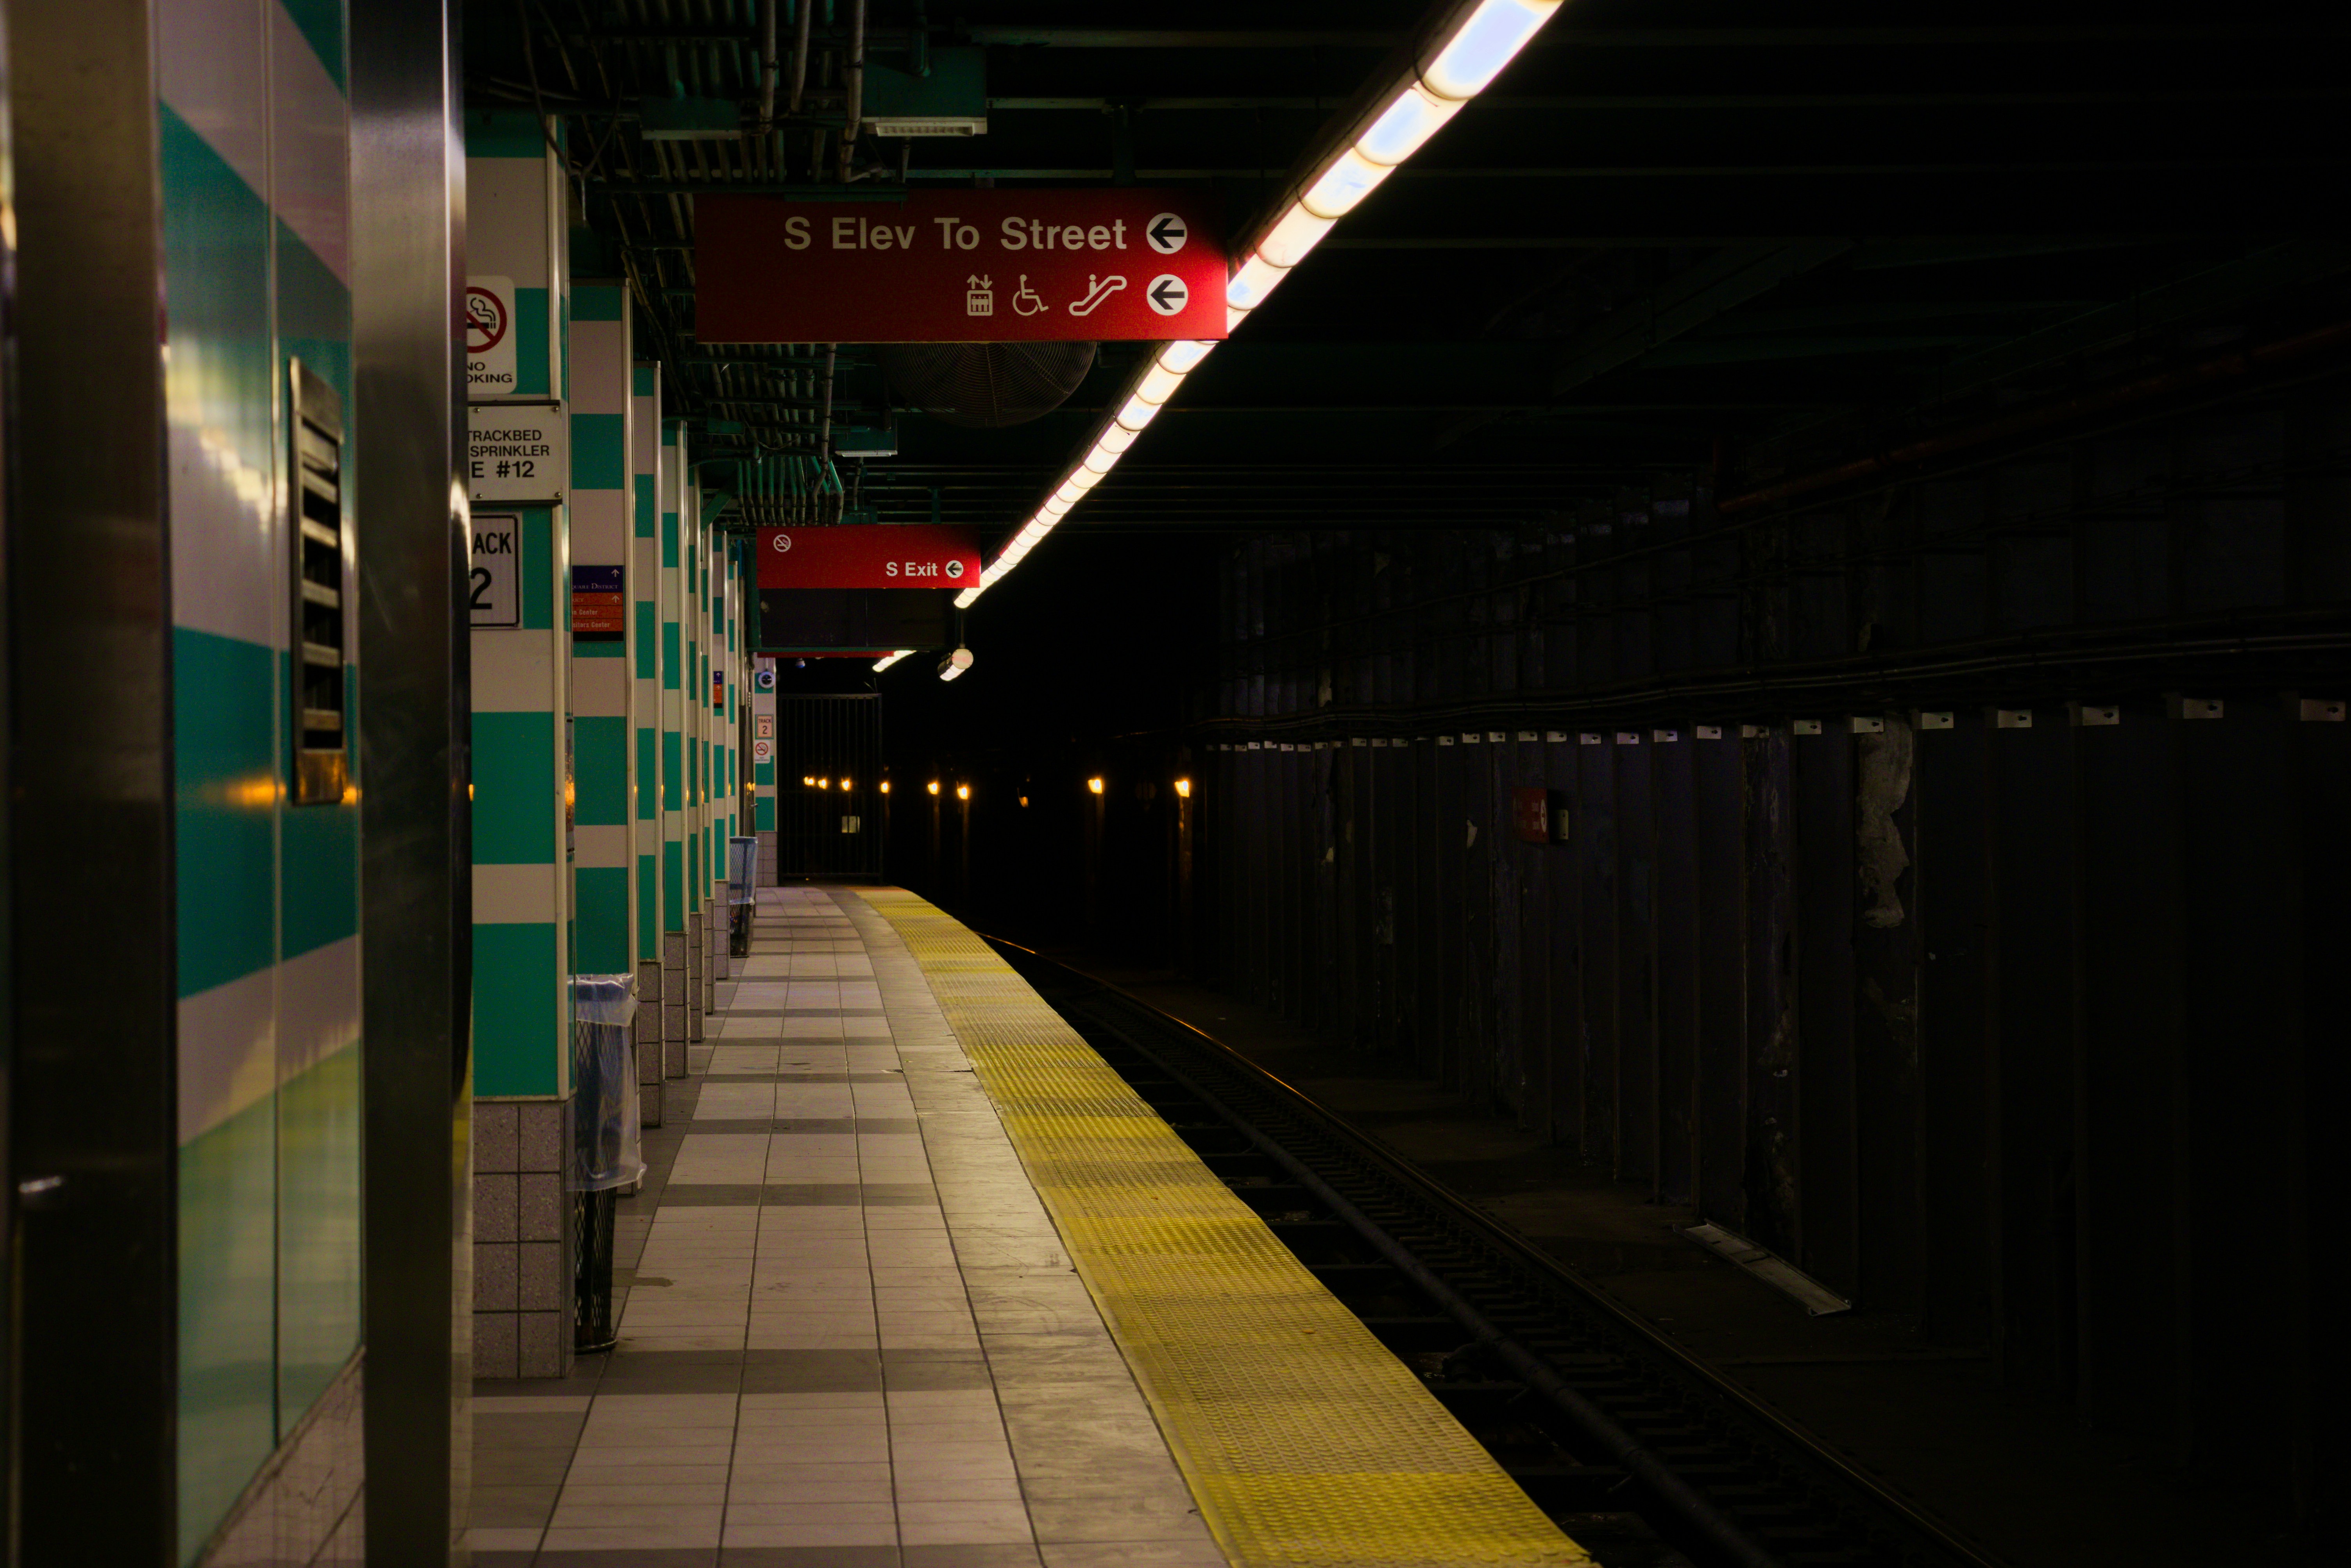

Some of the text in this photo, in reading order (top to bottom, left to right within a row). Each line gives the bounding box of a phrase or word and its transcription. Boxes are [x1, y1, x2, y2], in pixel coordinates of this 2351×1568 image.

[784, 217, 1127, 250] S Elev To Street
[467, 374, 512, 383] OKING
[470, 445, 549, 457] SPRINKLER
[471, 460, 535, 478] E #12
[472, 532, 512, 554] ACK
[886, 562, 938, 576] S Exit
[470, 567, 492, 609] 2
[762, 725, 768, 734] 2
